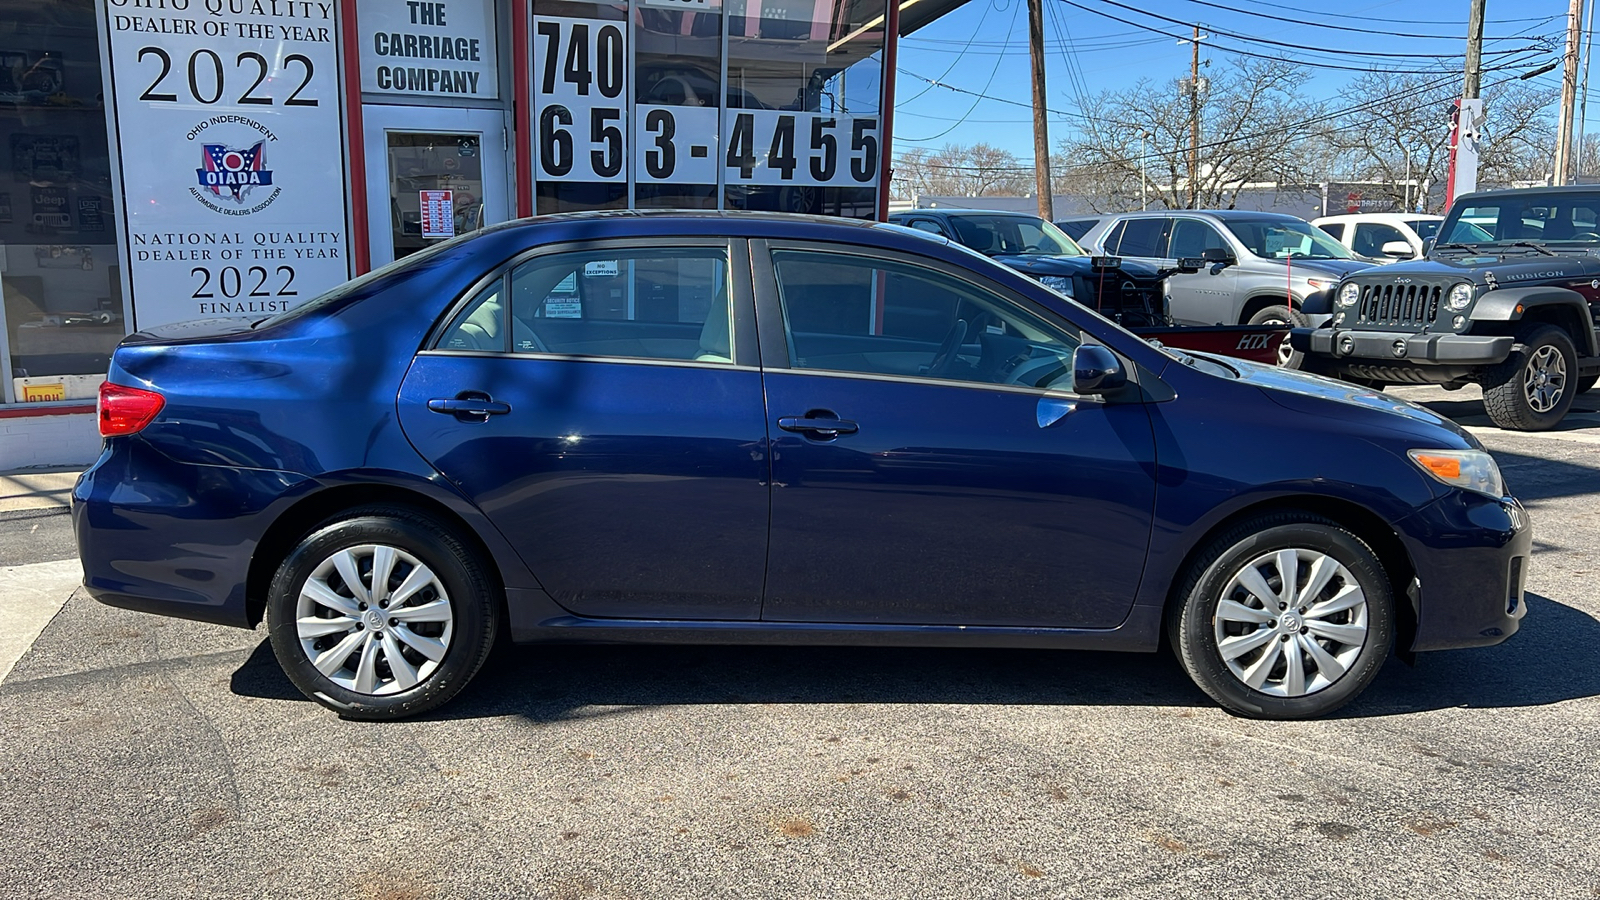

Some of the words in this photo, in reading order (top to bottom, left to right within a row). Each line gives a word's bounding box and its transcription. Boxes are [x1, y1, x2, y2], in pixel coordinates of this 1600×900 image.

[205, 0, 331, 20] QUALITY
[407, 1, 447, 26] THE
[114, 15, 198, 35] DEALER
[203, 21, 230, 37] OF
[235, 23, 275, 40] THE
[279, 25, 331, 42] YEAR
[374, 32, 480, 61] CARRIAGE
[537, 21, 624, 98] 740
[137, 46, 319, 107] 2022
[377, 66, 480, 94] COMPANY
[186, 121, 209, 141] OHIO
[209, 115, 278, 142] INDEPENDENT
[206, 172, 261, 185] OIADA
[35, 194, 66, 206] Jeep
[189, 186, 223, 214] AUTOMOBILE
[223, 208, 251, 216] DEALERS
[251, 186, 282, 214] ASSOCIATION
[133, 233, 244, 245] NATIONAL
[253, 232, 340, 246] QUALITY
[138, 250, 212, 261] DEALER
[221, 250, 243, 260] OF
[251, 249, 286, 259] THE
[294, 248, 340, 259] YEAR
[190, 265, 298, 299] 2022
[1506, 270, 1564, 281] RUBICON
[200, 301, 289, 314] FINALIST
[1236, 333, 1275, 350] HTX
